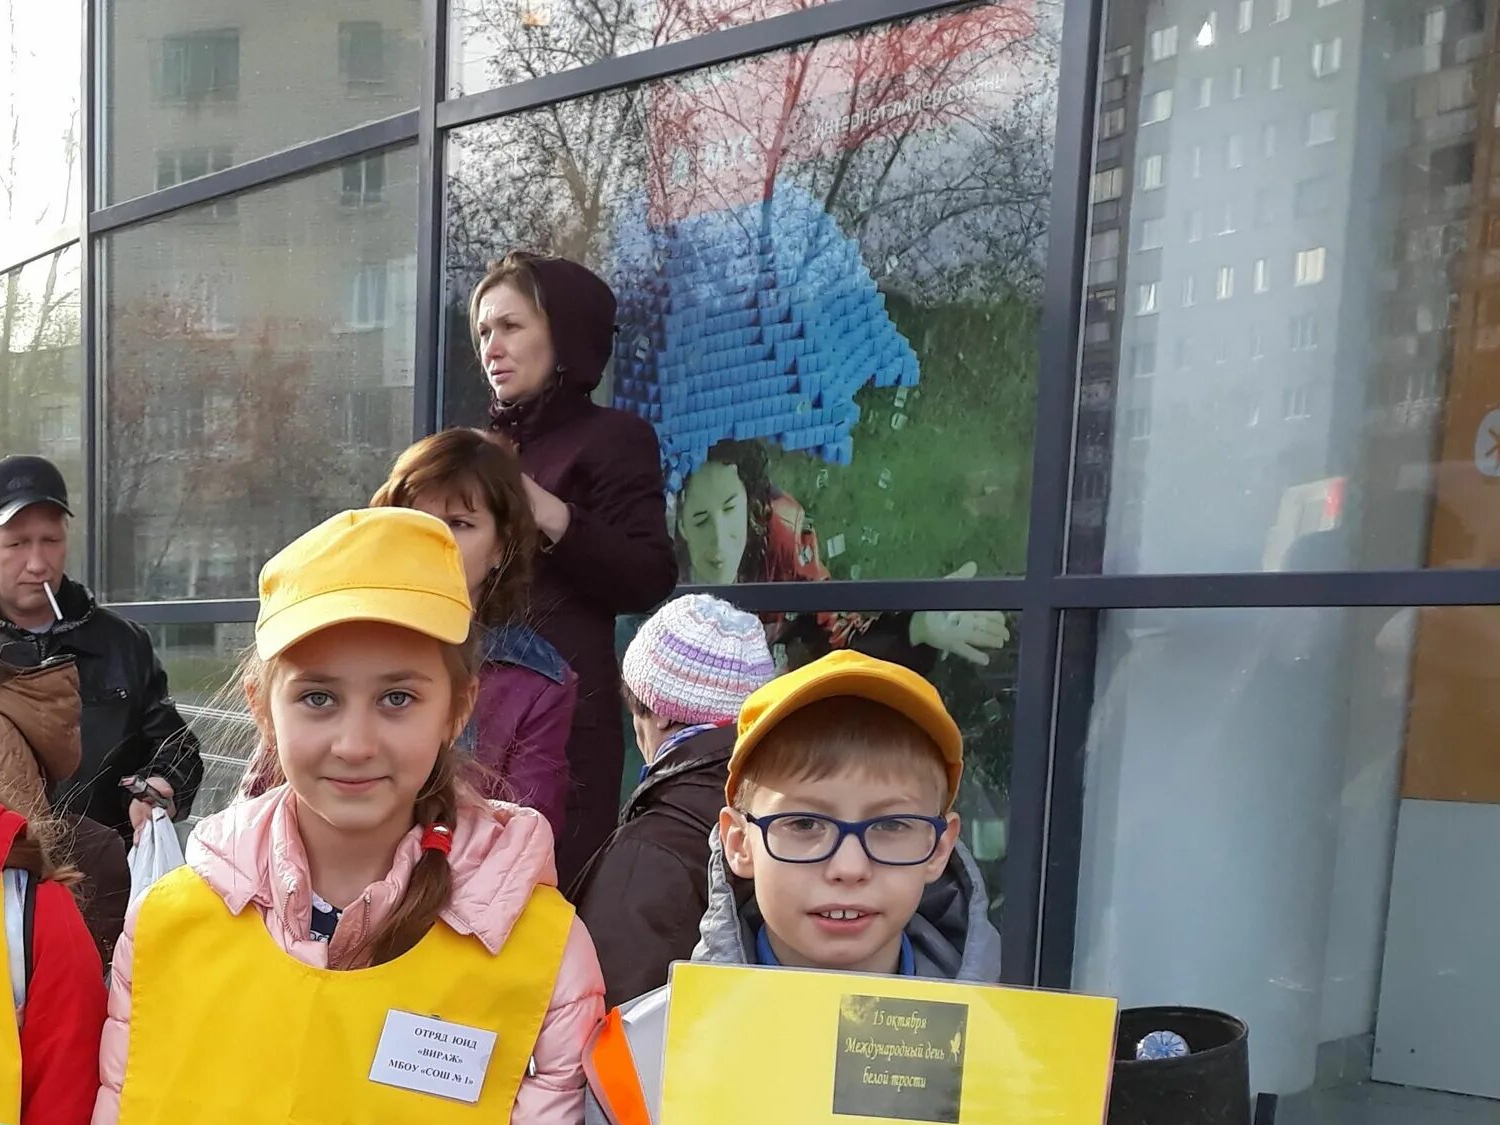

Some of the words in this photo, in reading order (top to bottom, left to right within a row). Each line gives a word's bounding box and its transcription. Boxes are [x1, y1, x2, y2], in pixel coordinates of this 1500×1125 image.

[873, 1010, 885, 1025] 15
[886, 1011, 927, 1034] октября
[414, 1027, 448, 1043] ОТРЯД
[452, 1036, 477, 1050] ЮИД
[845, 1037, 923, 1061] Международный
[925, 1041, 945, 1060] день
[418, 1048, 463, 1064] «ВИРАЖ»
[388, 1059, 419, 1072] МБОУ
[420, 1067, 451, 1080] «СОШ
[863, 1066, 889, 1085] белой
[891, 1074, 927, 1092] трости
